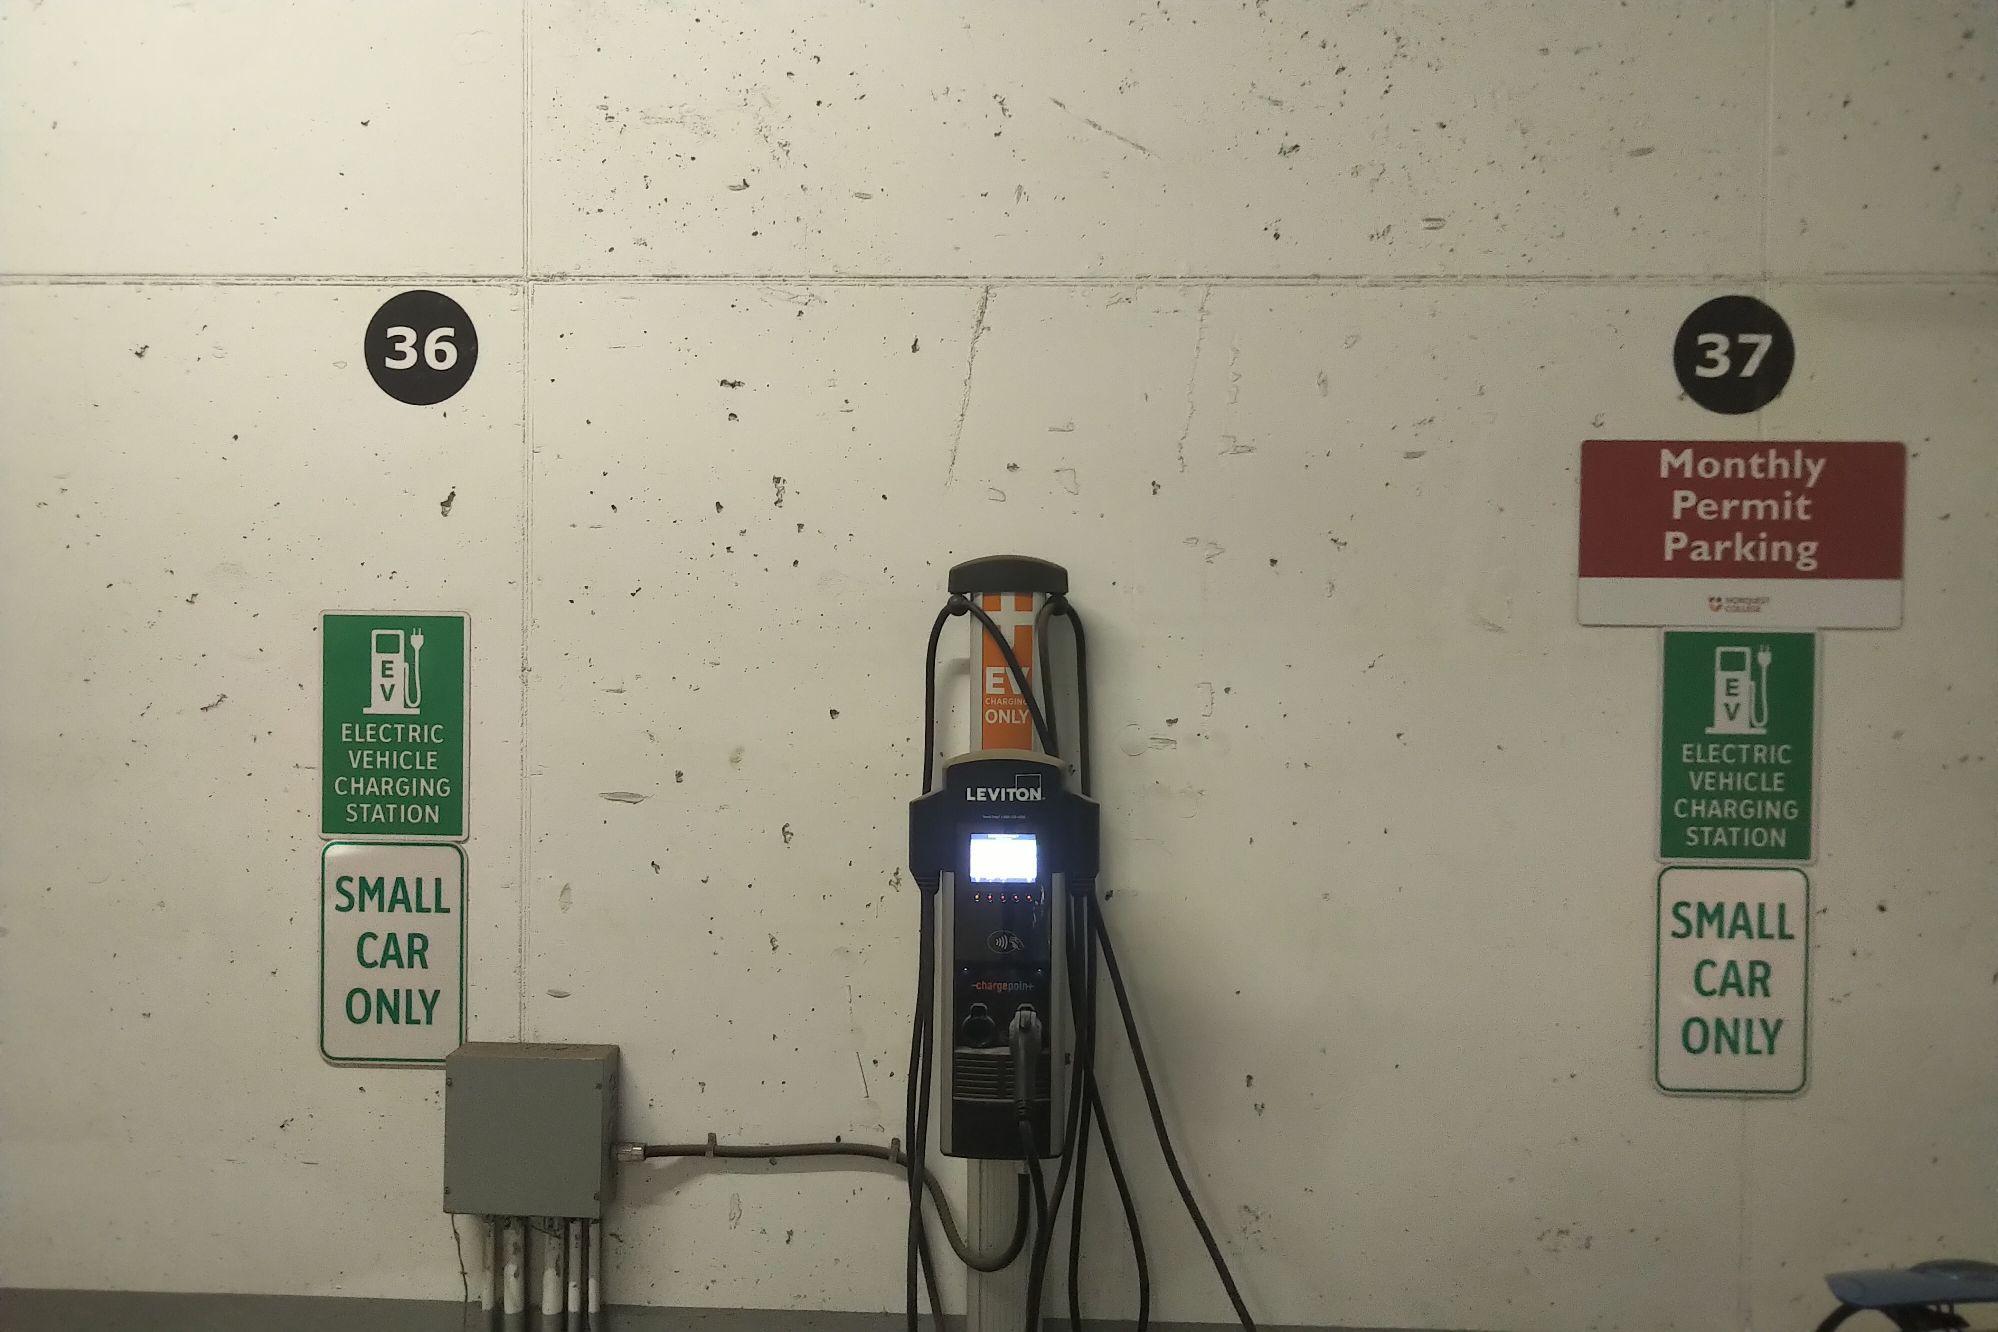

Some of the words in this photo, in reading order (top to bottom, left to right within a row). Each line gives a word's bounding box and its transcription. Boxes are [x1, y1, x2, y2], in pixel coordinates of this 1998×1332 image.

[385, 326, 458, 371] 36
[1695, 333, 1773, 379] 37
[1659, 449, 1826, 488] Monthly
[1672, 489, 1812, 520] Permit
[1663, 531, 1819, 571] Parking
[985, 666, 1030, 695] EV
[984, 708, 1030, 724] ONLY
[341, 723, 444, 744] ELECTRIC
[348, 750, 438, 770] VEHICLE
[1682, 743, 1792, 765] ELECTRIC
[334, 776, 451, 797] CHARGING
[966, 787, 1042, 802] LEVITON
[1688, 771, 1786, 792] VEHICLE
[346, 804, 440, 824] STATION
[1673, 798, 1799, 820] CHARGING
[1685, 826, 1787, 848] STATION
[334, 875, 451, 914] SMALL
[1671, 900, 1795, 940] SMALL
[356, 931, 429, 970] CAR
[1693, 958, 1771, 998] CAR
[345, 987, 441, 1026] ONLY
[1681, 1015, 1784, 1056] ONLY
